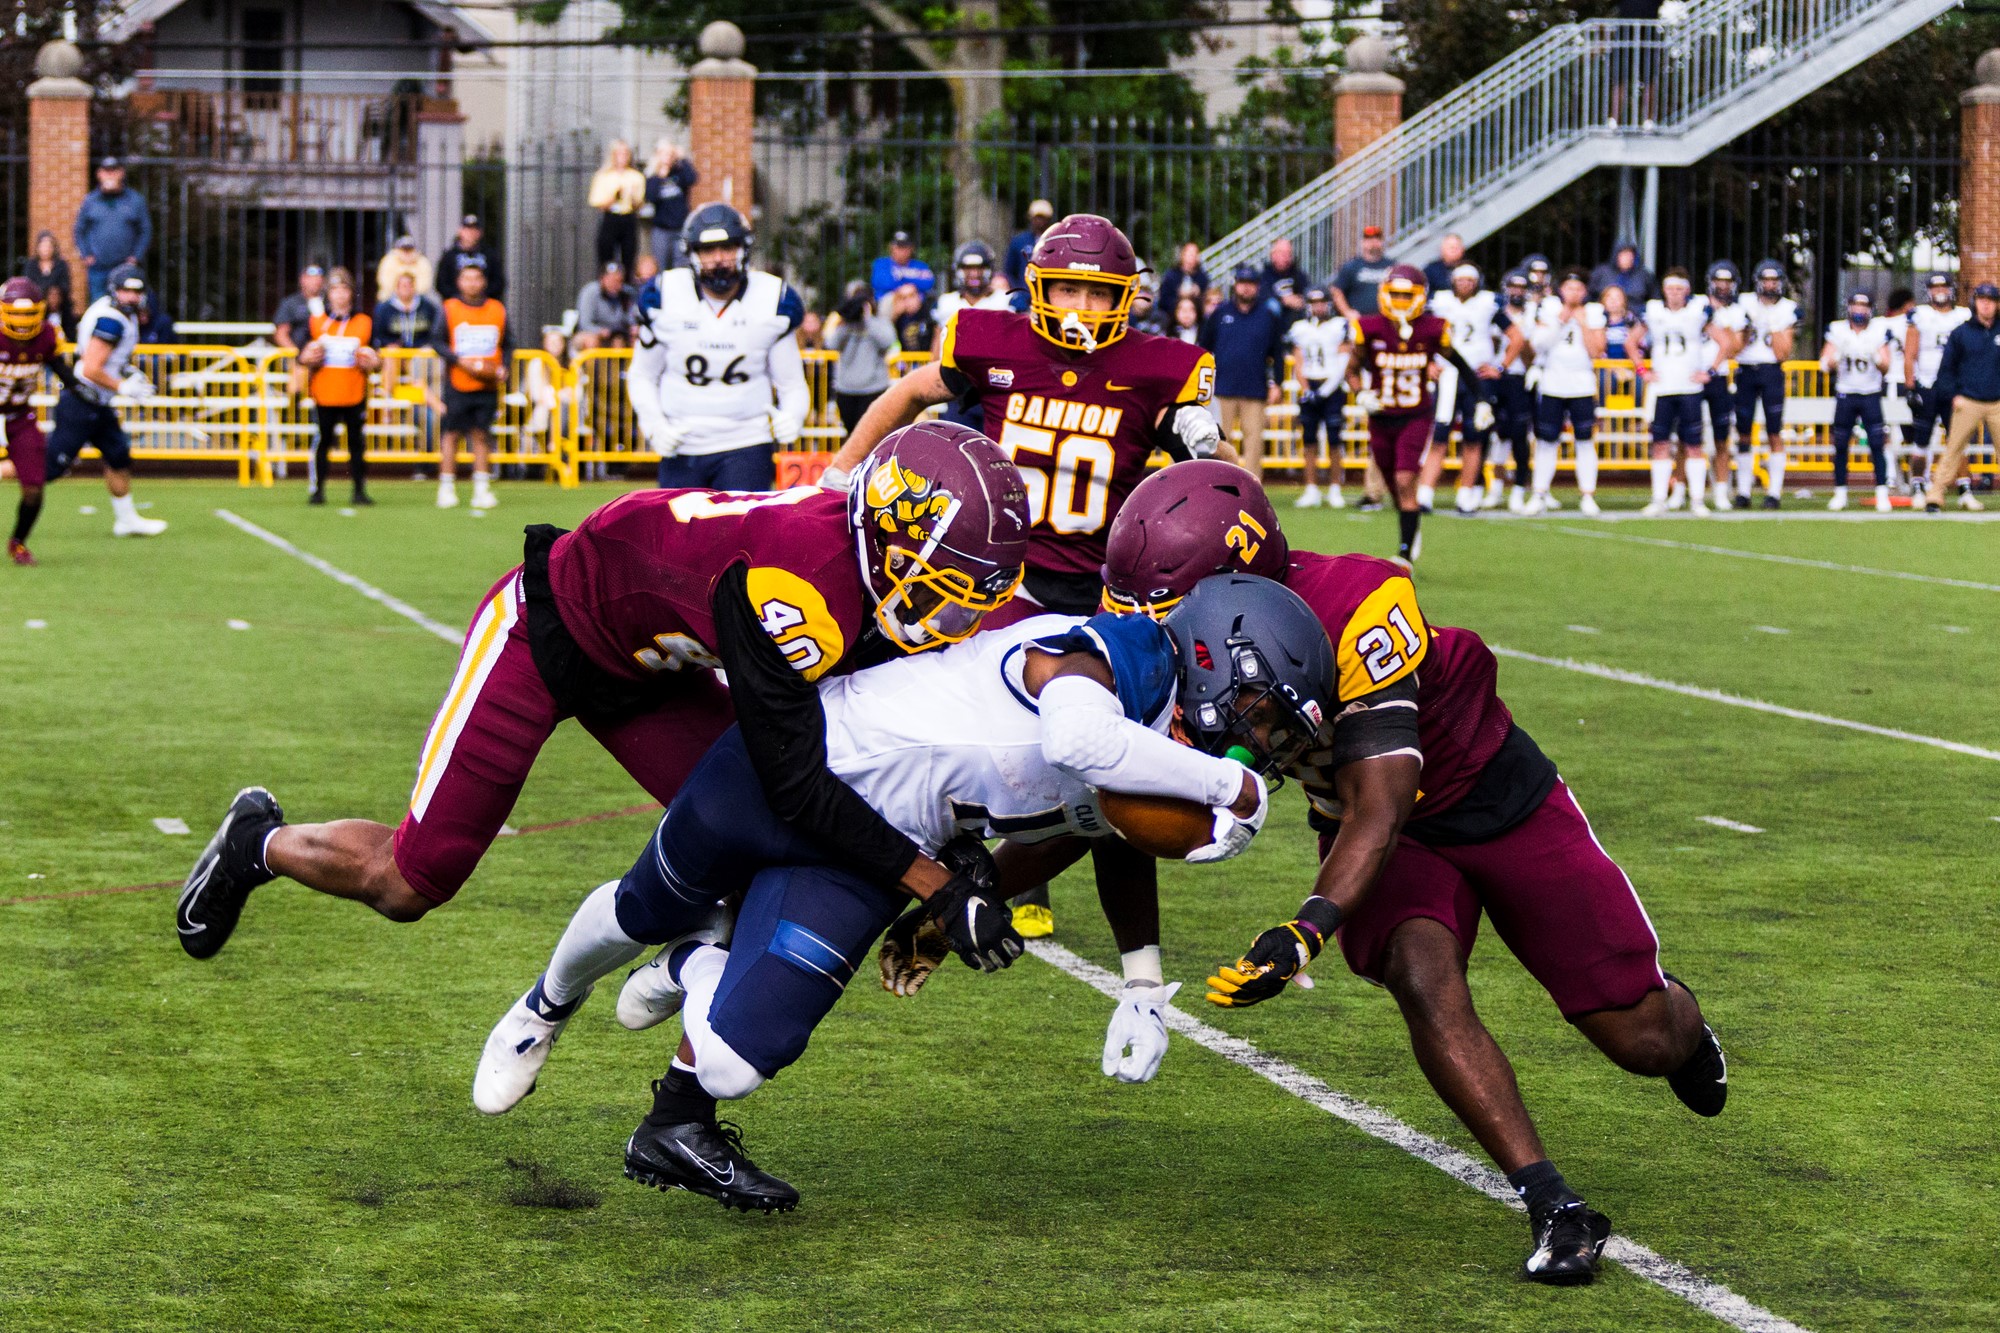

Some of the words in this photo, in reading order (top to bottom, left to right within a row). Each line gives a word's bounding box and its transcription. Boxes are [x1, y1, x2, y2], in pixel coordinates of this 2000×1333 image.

[685, 354, 750, 387] 86
[1005, 393, 1124, 437] GANNON
[999, 419, 1117, 536] 50
[1224, 509, 1267, 566] 21
[758, 597, 823, 671] 40
[1354, 602, 1422, 686] 21
